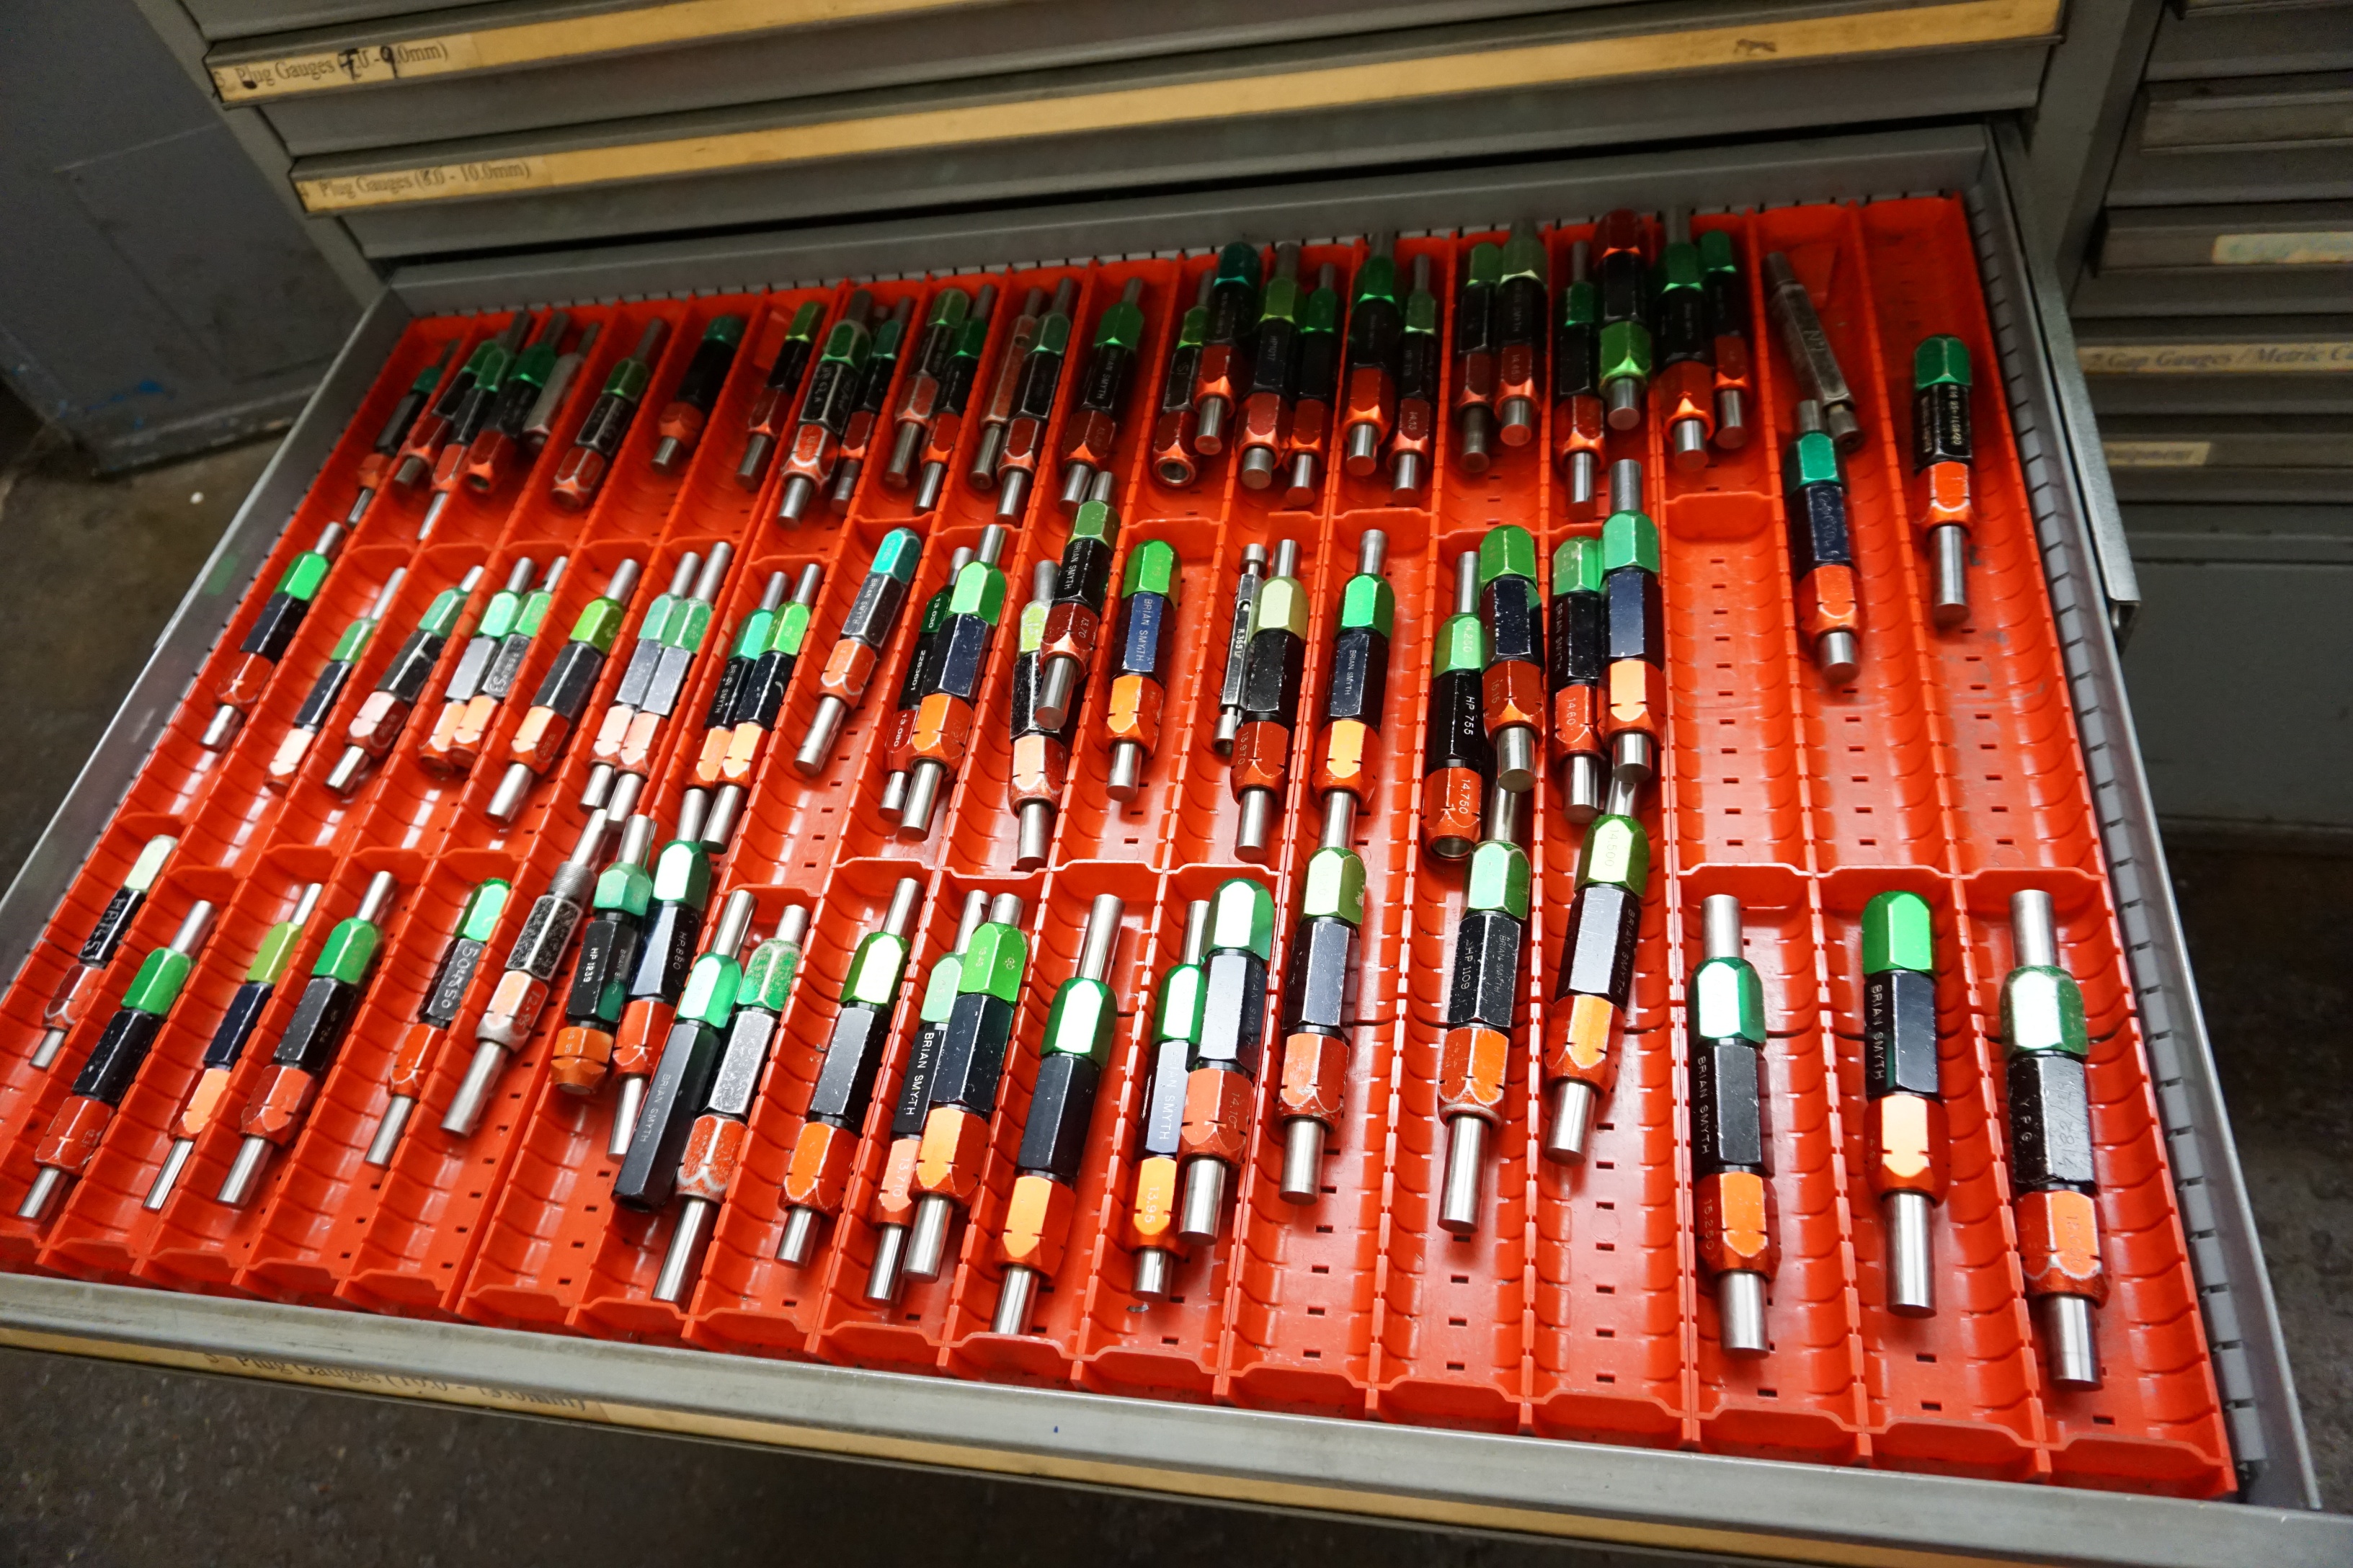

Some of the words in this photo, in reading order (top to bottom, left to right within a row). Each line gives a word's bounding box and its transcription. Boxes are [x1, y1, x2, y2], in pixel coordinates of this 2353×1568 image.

[234, 66, 275, 87] Plug
[275, 60, 335, 81] Gauges
[319, 180, 357, 200] Plug
[356, 175, 414, 193] Gauges
[1267, 335, 1278, 361] HP1017
[1096, 373, 1112, 400] SMYTH
[1069, 541, 1082, 563] BRIAN
[863, 577, 879, 600] BRIAN
[1063, 565, 1078, 590] SMYTH
[852, 600, 868, 626] SMYTH
[927, 596, 942, 629] 13.030
[1141, 598, 1154, 626] BRIAN
[1554, 603, 1563, 633] BRIAN
[1077, 617, 1090, 639] 13.70
[1462, 620, 1474, 652] 14.250
[1135, 630, 1149, 662] SMYTH
[1347, 649, 1358, 670] BRIAN
[1554, 636, 1564, 672] SMYTH
[909, 650, 927, 691] 2263601
[1344, 671, 1354, 696] SMYTH
[713, 688, 729, 714] SMYTH
[1464, 695, 1475, 710] HP
[1565, 697, 1577, 726] 14.60
[893, 713, 908, 748] 13.080
[1463, 715, 1475, 736] 755
[1237, 730, 1250, 765] 13.970
[1459, 778, 1471, 815] 14.750
[1603, 828, 1620, 868] 14.500
[1622, 908, 1636, 946] BRIAN
[589, 946, 600, 960] HP
[615, 948, 627, 968] BRIAN
[1463, 947, 1475, 961] HP
[1497, 934, 1508, 961] BRIAN
[582, 961, 597, 983] 1239
[1249, 962, 1263, 1002] BRIAN
[1460, 966, 1472, 990] 1109
[1493, 962, 1505, 993] SMYTH
[1615, 951, 1630, 997] SMYTH
[1871, 984, 1884, 1026] BRIAN
[1245, 1005, 1258, 1050] SMYTH
[916, 1032, 935, 1069] BRIAN
[1872, 1031, 1885, 1079] SMYTH
[651, 1072, 672, 1102] BRIAN
[1696, 1055, 1708, 1098] BRIAN
[904, 1074, 925, 1116] SMYTH
[638, 1107, 659, 1143] SMYTH
[1158, 1094, 1177, 1140] SMYTH
[1699, 1105, 1710, 1154] SMYTH
[891, 1157, 912, 1198] 13.710
[1144, 1185, 1160, 1224] 13.95
[1704, 1198, 1715, 1250] 15.250
